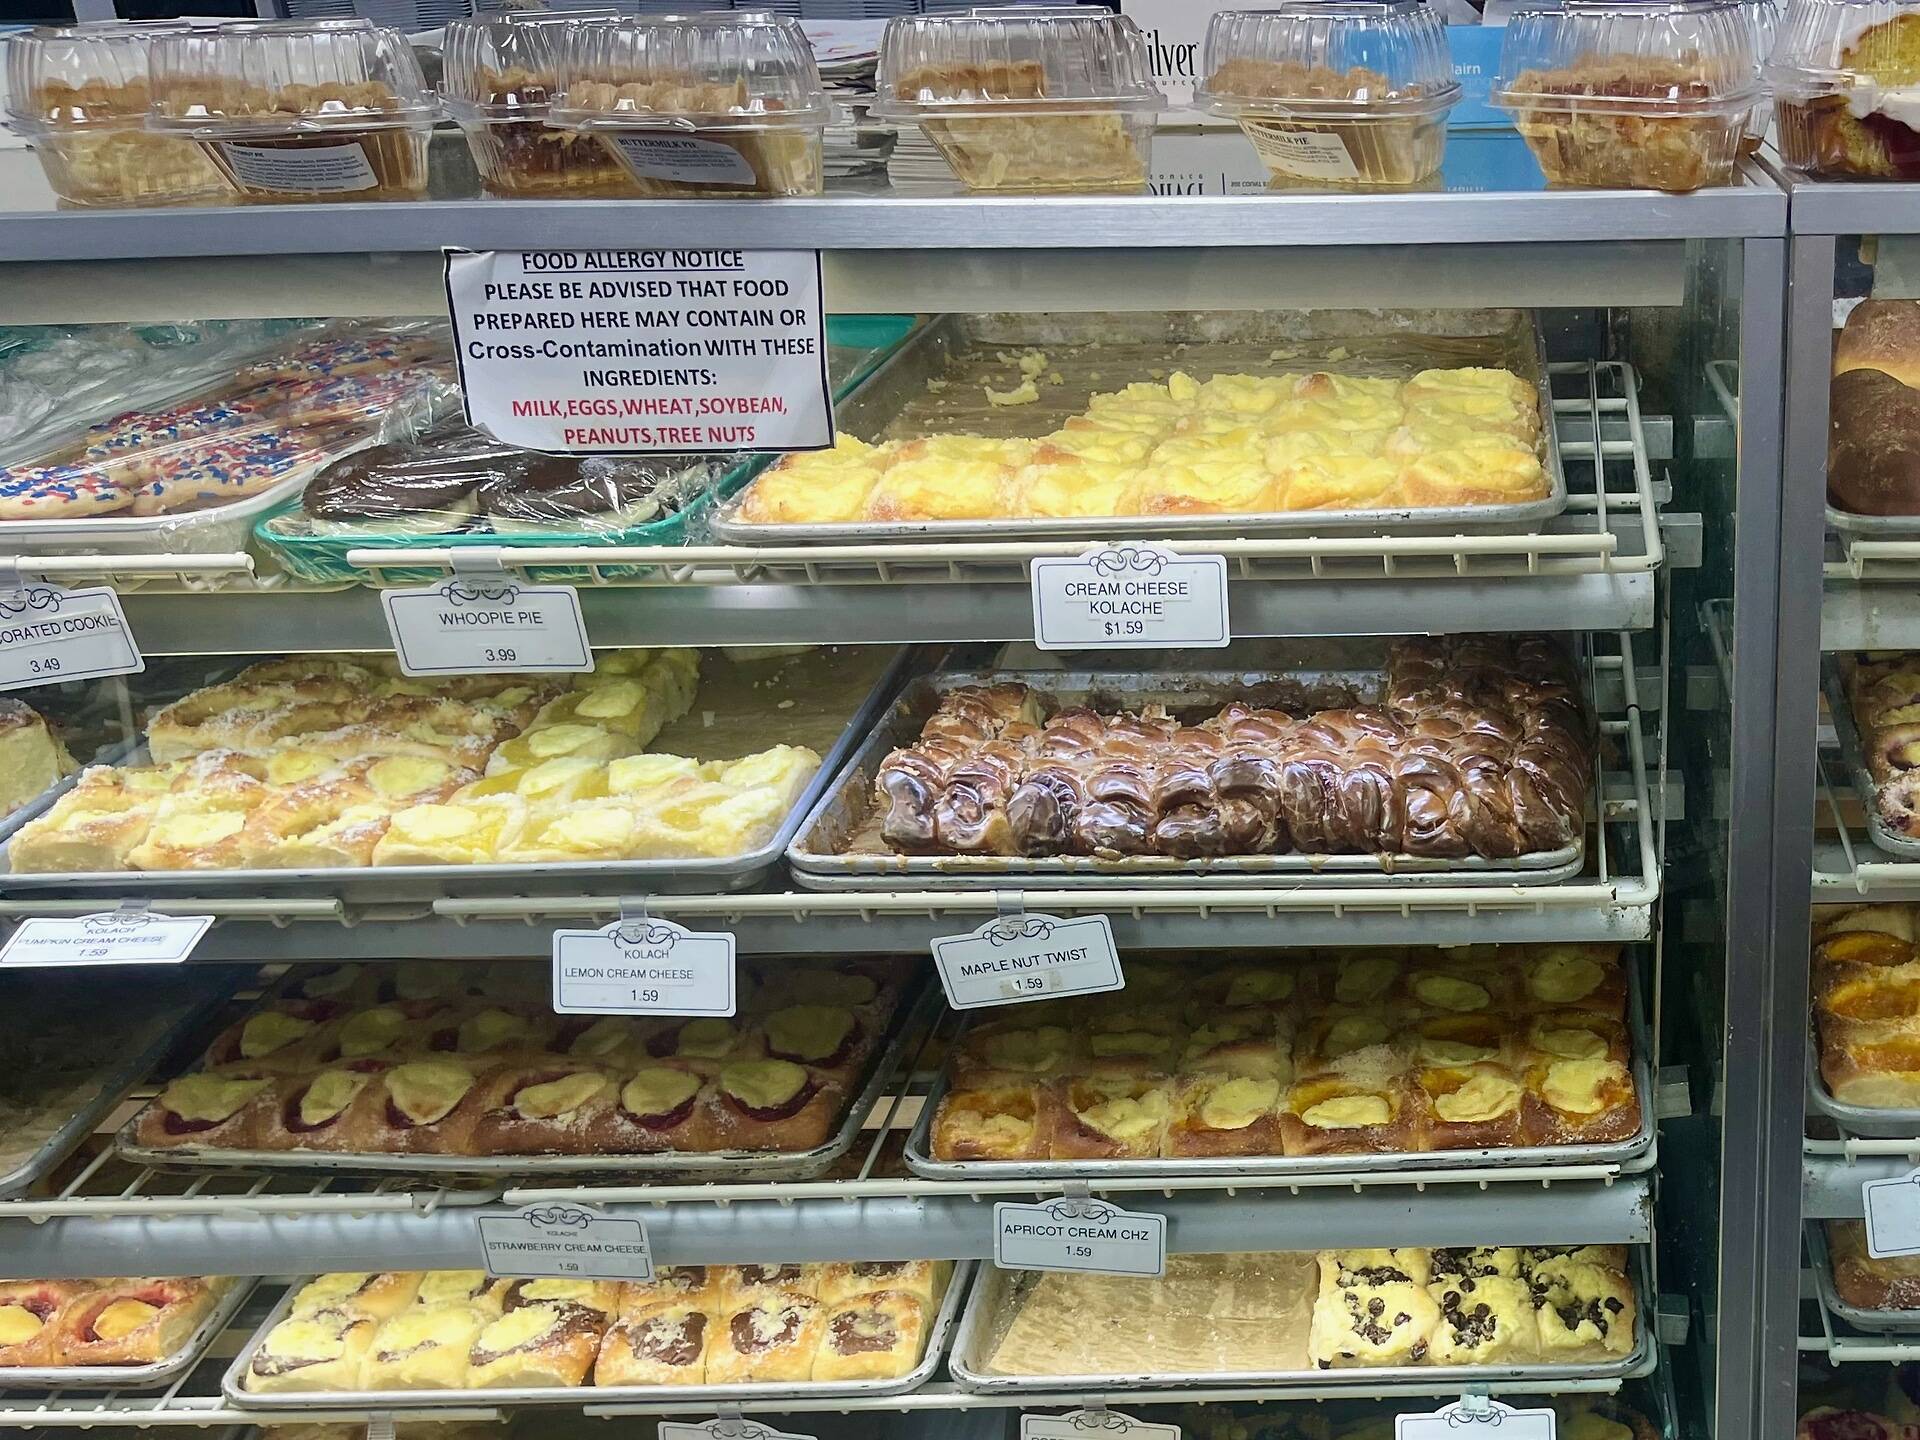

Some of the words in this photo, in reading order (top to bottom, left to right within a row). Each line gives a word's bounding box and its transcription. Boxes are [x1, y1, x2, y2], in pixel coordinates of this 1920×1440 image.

[1139, 29, 1198, 77] ilver
[617, 138, 681, 148] BUTTERMILK
[1294, 137, 1309, 145] PIE
[522, 252, 578, 269] FOOD
[584, 251, 666, 269] ALLERGY
[672, 250, 744, 268] NOTICE
[484, 282, 554, 300] PLEASE
[559, 282, 583, 299] BE
[589, 281, 672, 298] ADVISED
[677, 280, 727, 297] THAT
[733, 279, 789, 297] FOOD
[473, 312, 575, 330] PREPARED
[580, 311, 631, 329] HERE
[635, 310, 680, 327] MAY
[686, 309, 774, 327] CONTAIN
[779, 309, 806, 326] OR
[468, 338, 701, 359] Cross-Contamination
[704, 339, 756, 357] WITH
[761, 338, 815, 355] THESE
[583, 369, 718, 387] INGREDIENTS:
[708, 425, 756, 443] NUTS
[1064, 582, 1121, 596] CREAM
[1125, 581, 1188, 596] CHEESE
[1090, 601, 1163, 615] KOLACHE
[439, 611, 515, 625] WHOOPIE
[518, 611, 543, 624] PIE
[0, 622, 61, 644] ORATED
[1104, 620, 1144, 636] $1.59
[485, 648, 517, 662] 3.99
[30, 657, 61, 673] 3.49
[86, 927, 137, 935] KOLACH
[73, 937, 116, 945] CREAM
[117, 935, 167, 944] CHEESE
[624, 949, 669, 960] KOLACH
[960, 959, 1010, 976] MAPLE
[1012, 954, 1041, 969] NUT
[1043, 947, 1088, 964] TWIST
[564, 967, 604, 978] LEMON
[607, 968, 646, 979] CREAM
[649, 969, 694, 980] CHEESE
[1015, 977, 1044, 990] 1.59
[631, 989, 659, 1002] 1.59
[1004, 1224, 1064, 1237] APRICOT
[1068, 1227, 1117, 1239] CREAM
[1121, 1229, 1150, 1241] CHZ
[488, 1241, 561, 1251] STRAWBERRY
[564, 1243, 602, 1252] CREAM
[604, 1245, 648, 1254] CHEESE
[1065, 1245, 1093, 1257] 1.59
